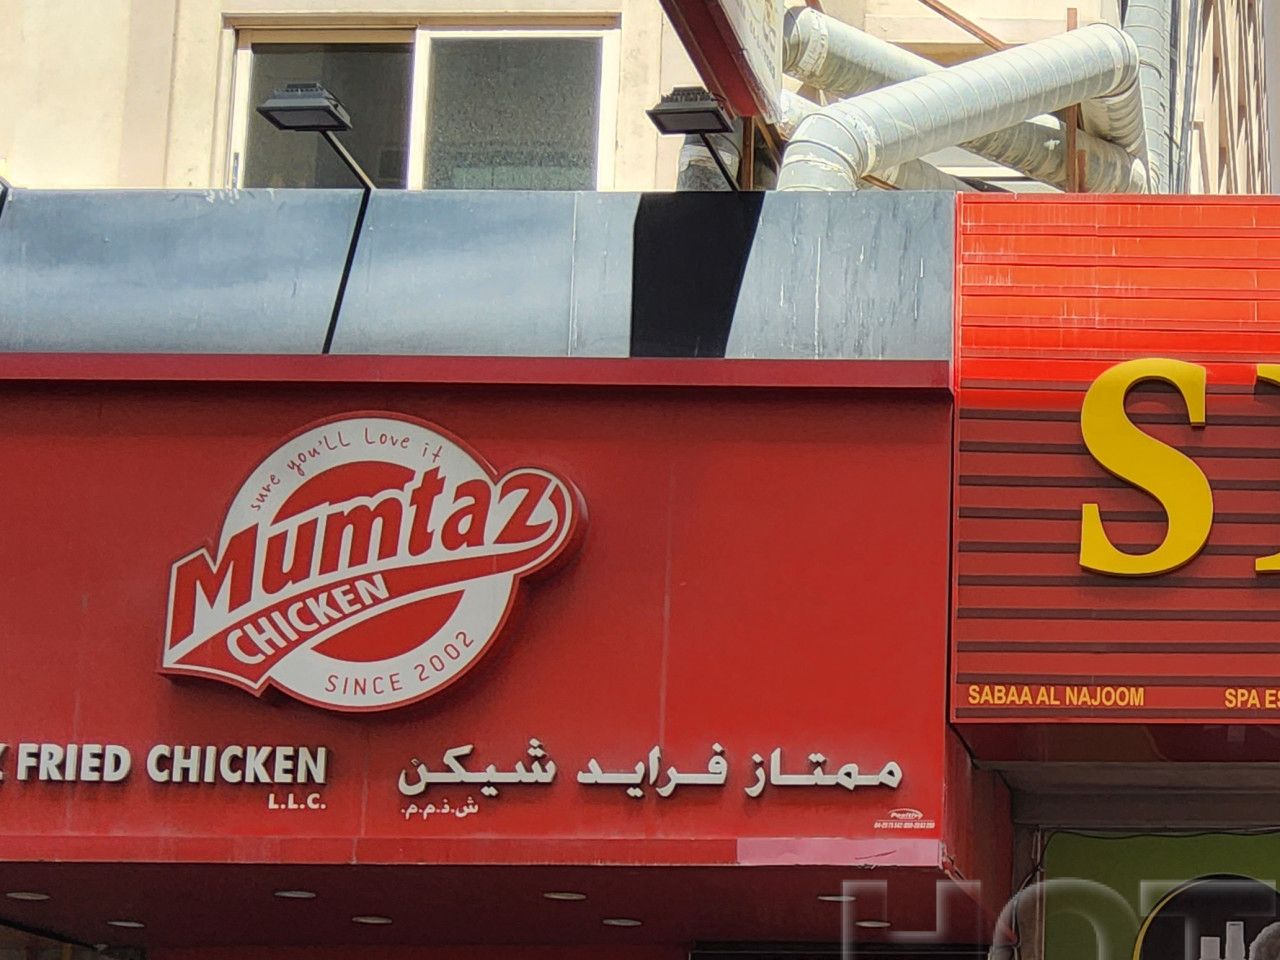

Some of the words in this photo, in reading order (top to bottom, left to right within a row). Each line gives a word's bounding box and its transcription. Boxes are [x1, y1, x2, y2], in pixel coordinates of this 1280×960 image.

[250, 473, 282, 513] sure
[422, 442, 444, 464] it
[168, 464, 560, 651] Mumtaz
[225, 573, 391, 666] CHICKEN
[324, 672, 403, 696] SINCE
[413, 630, 475, 682] 2002
[968, 685, 1033, 706] SABAA
[1036, 685, 1061, 706] AL
[1065, 686, 1146, 707] NAJOOM
[1224, 688, 1261, 709] SPA
[16, 743, 133, 783] FRIED
[146, 744, 328, 784] CHICKEN
[397, 737, 559, 798] شيكن
[577, 742, 730, 799] فرايد
[745, 747, 904, 797] ممتاز
[268, 792, 327, 809] L.L.C.
